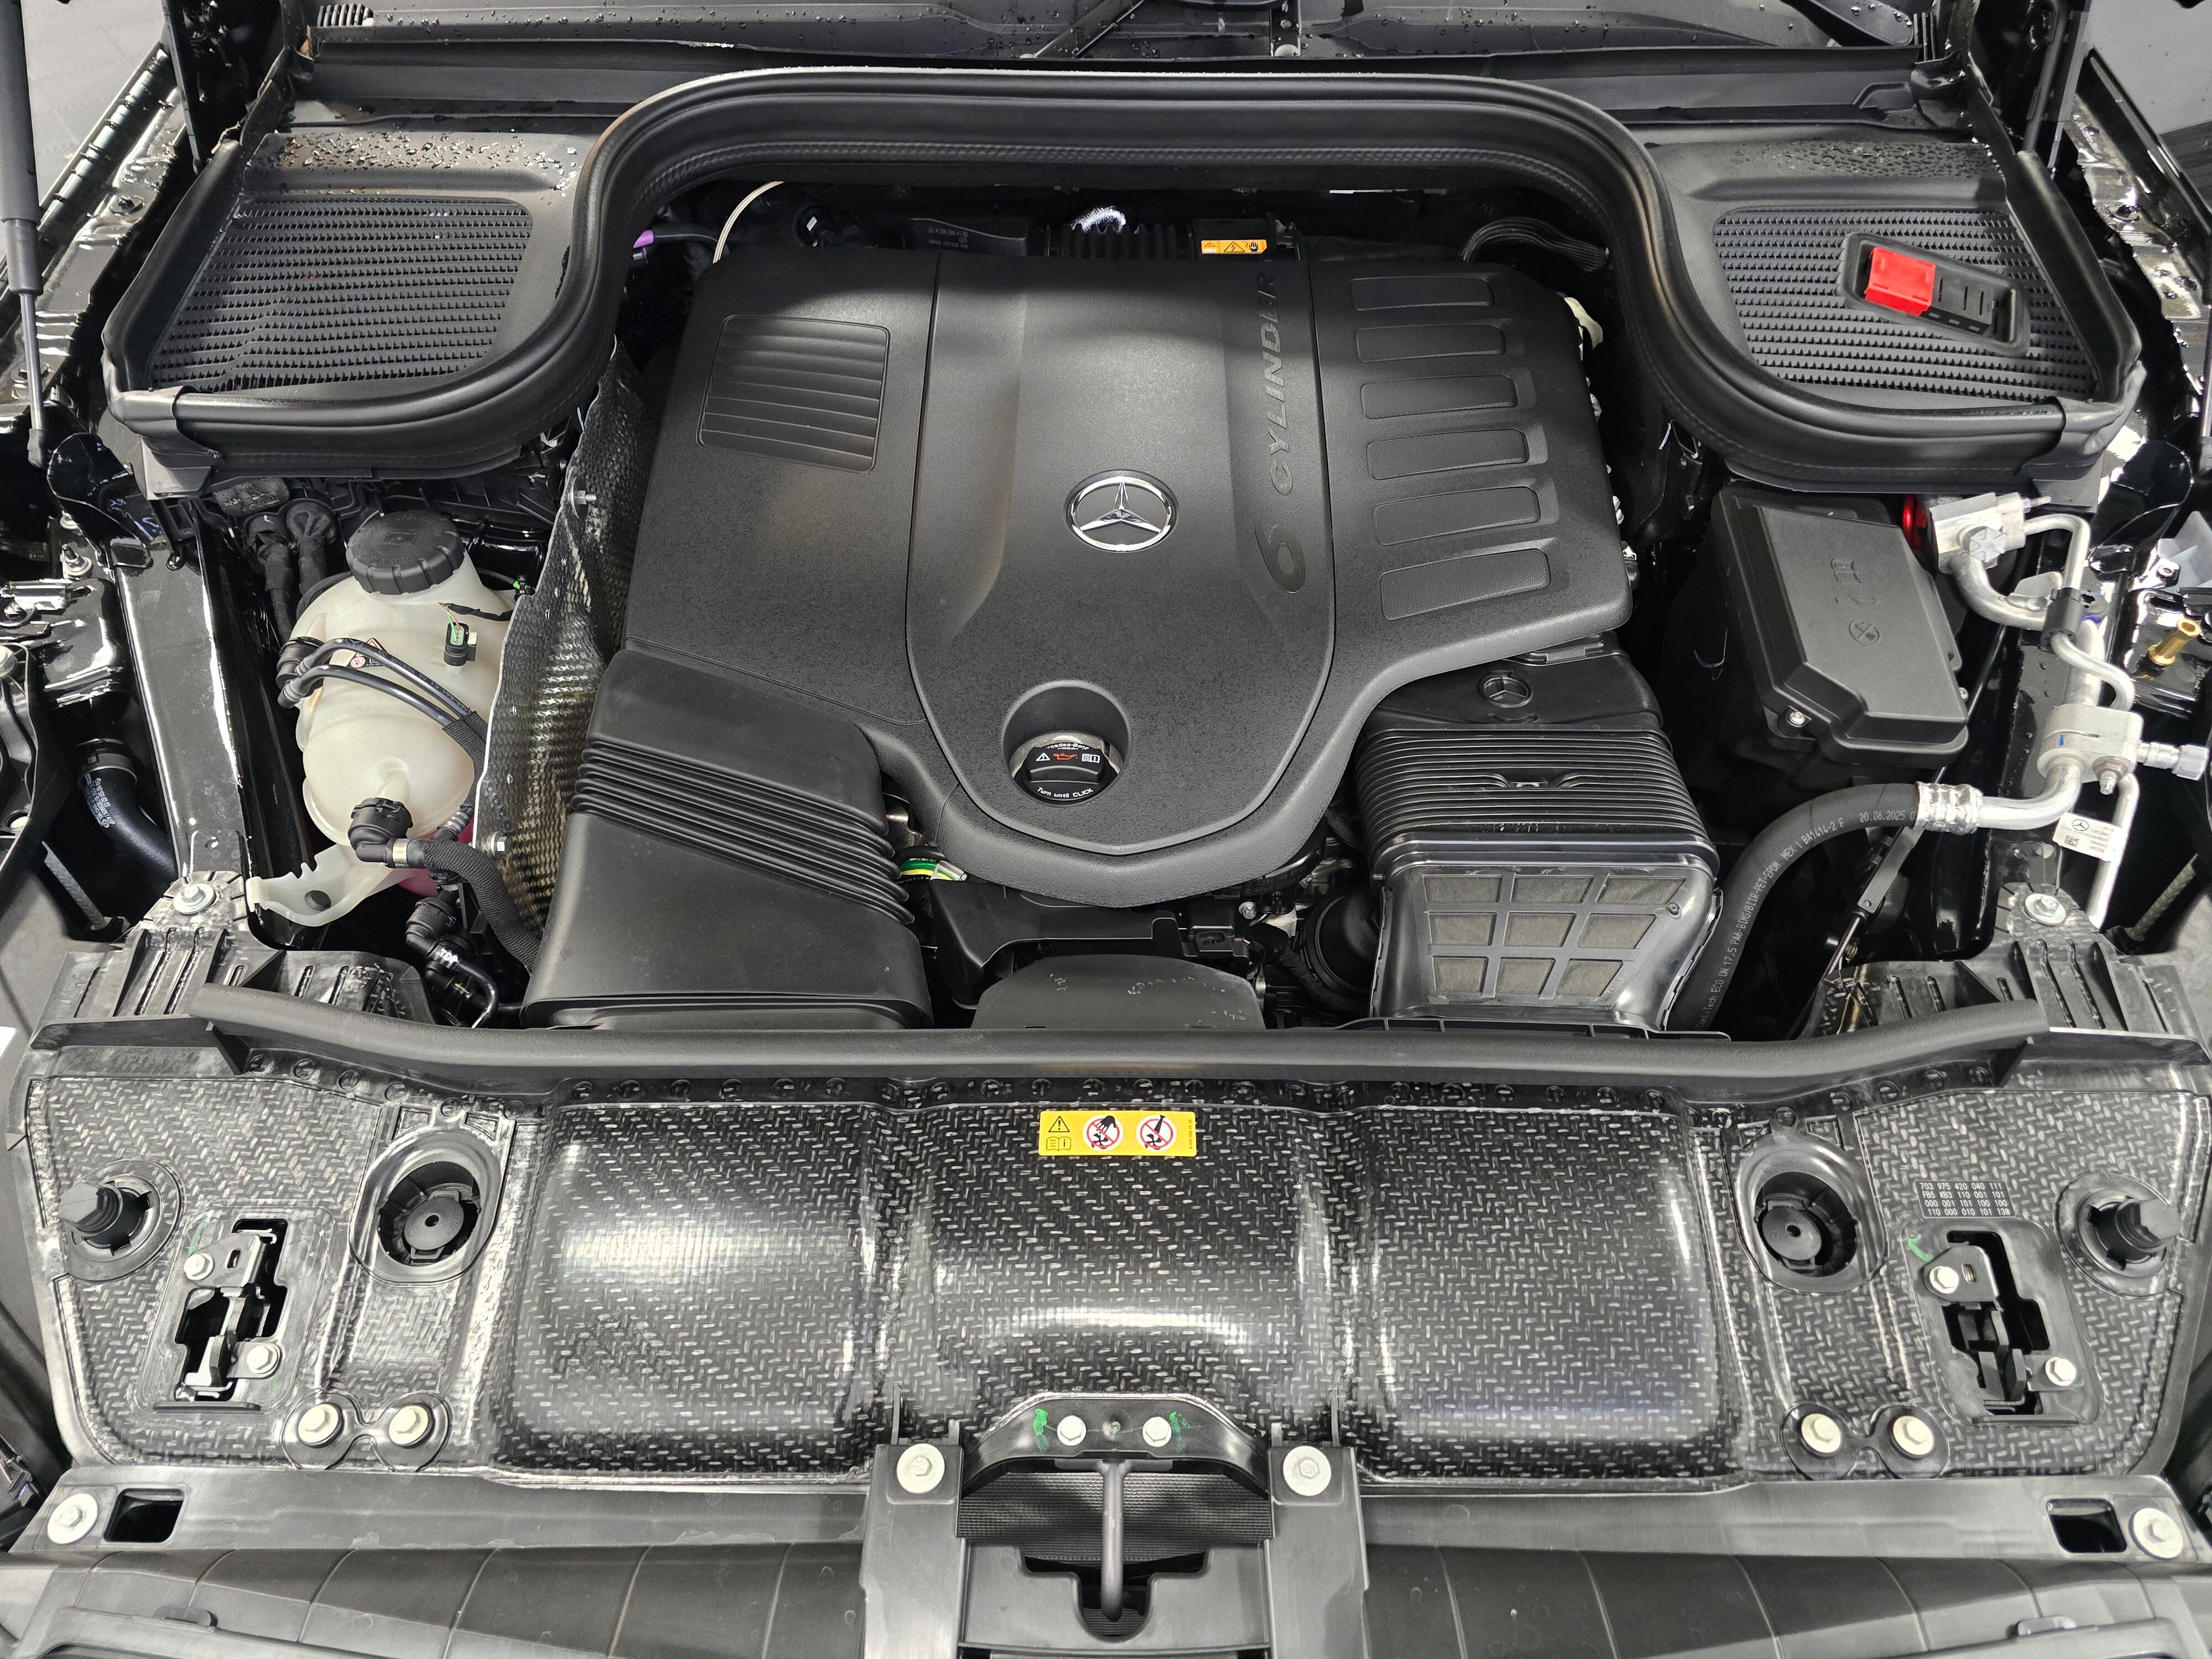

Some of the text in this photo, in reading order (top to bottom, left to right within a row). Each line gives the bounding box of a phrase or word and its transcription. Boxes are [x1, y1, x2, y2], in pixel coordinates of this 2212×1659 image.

[1254, 273, 1306, 593] 6 CYLINDER
[1037, 786, 1052, 796] Turn
[1072, 787, 1094, 798] CLICK
[1710, 980, 1725, 994] ECO
[1859, 810, 1906, 823] 20.06.2025
[439, 948, 459, 964] TOP
